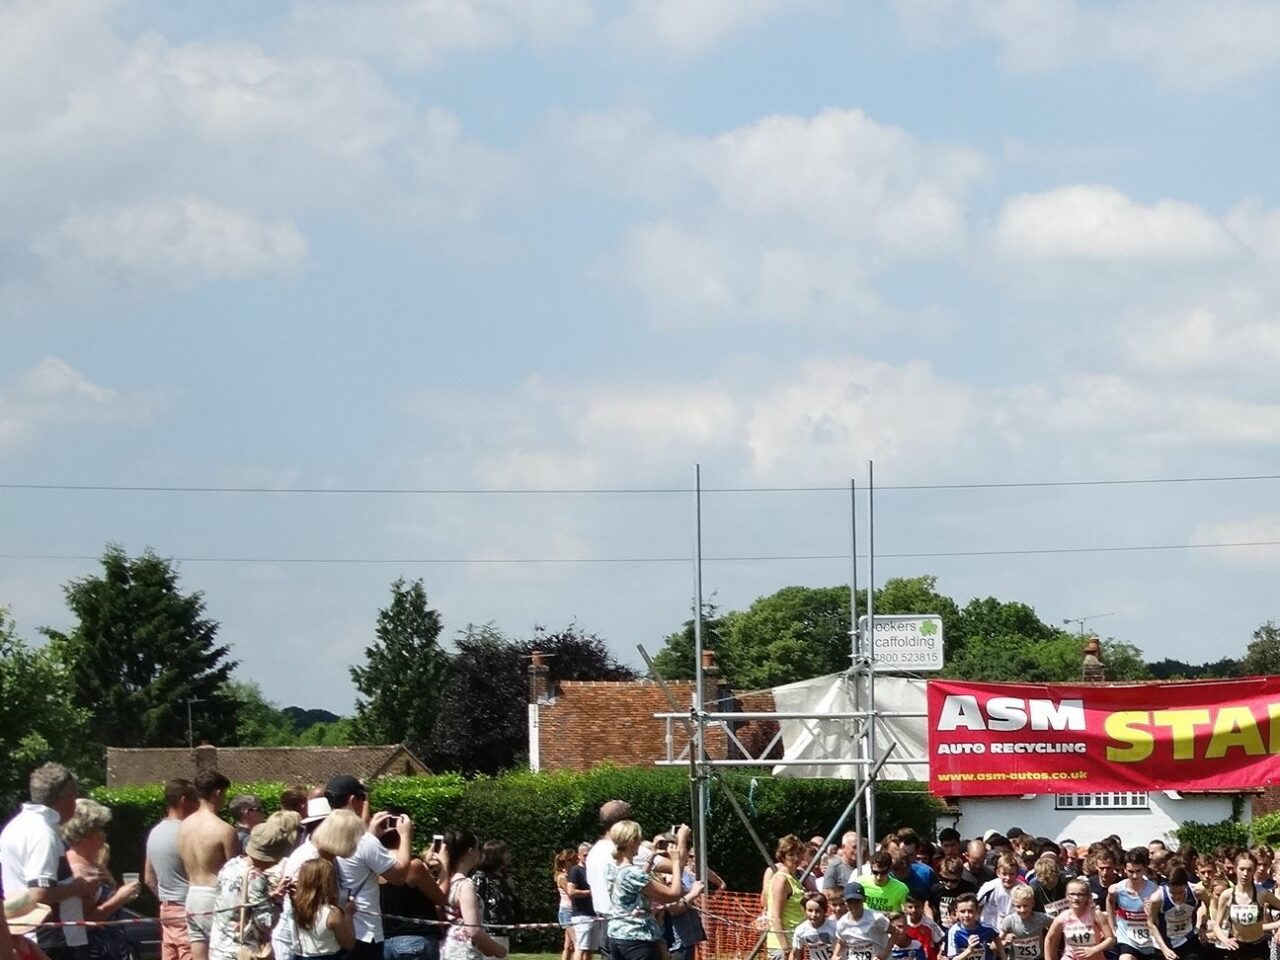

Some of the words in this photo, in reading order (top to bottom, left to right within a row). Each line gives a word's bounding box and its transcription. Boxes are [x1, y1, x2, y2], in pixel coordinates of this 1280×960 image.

[902, 652, 938, 662] 523815
[936, 694, 1087, 732] ASM
[937, 743, 986, 755] AUTO
[990, 742, 1087, 754] RECYCLING
[937, 770, 1088, 782] www.asm-autos.co.uk
[1071, 932, 1091, 944] 419
[1018, 944, 1038, 957] 253
